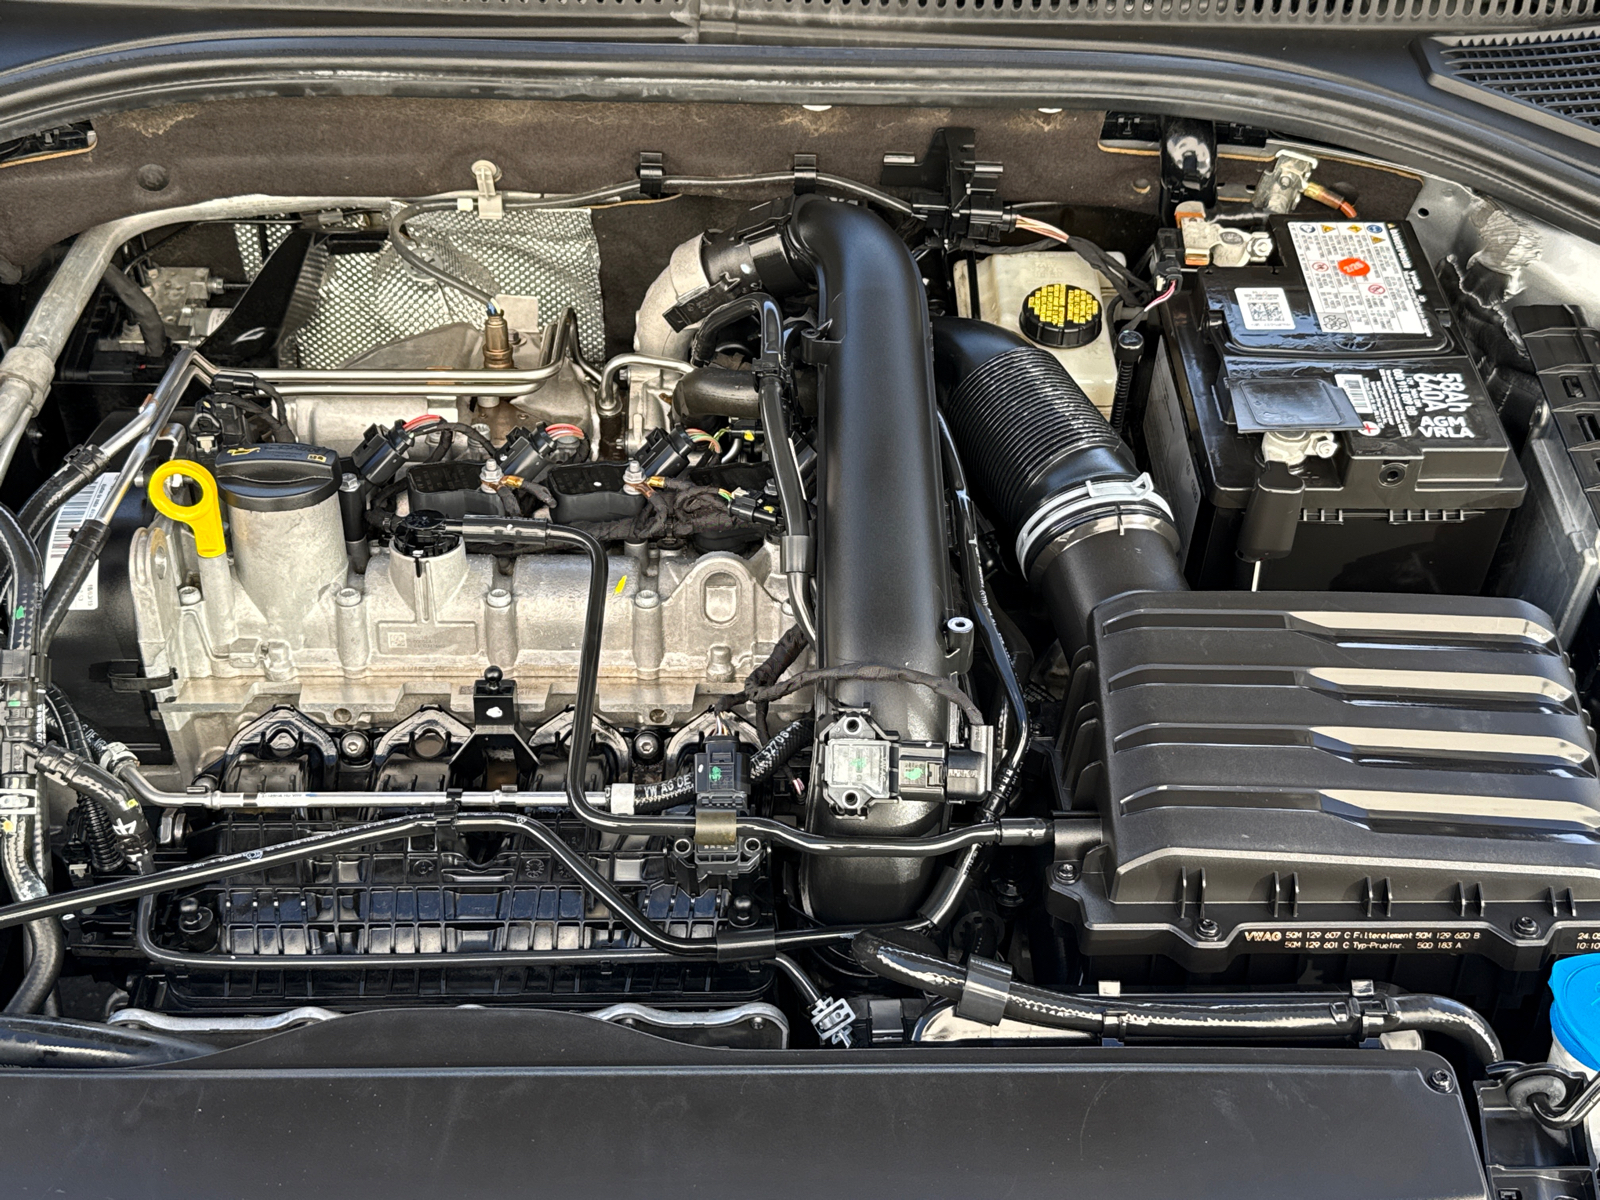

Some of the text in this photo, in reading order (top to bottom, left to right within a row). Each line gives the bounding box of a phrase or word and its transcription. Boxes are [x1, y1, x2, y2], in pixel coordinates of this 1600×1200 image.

[1397, 381, 1409, 393] 915
[1413, 373, 1449, 412] 640A
[1437, 373, 1473, 412] 58Ah
[1420, 416, 1467, 427] AGM
[1418, 427, 1475, 438] VRLA
[661, 780, 674, 794] AG
[1244, 931, 1282, 941] VWAG
[1306, 931, 1321, 939] 129
[1324, 931, 1341, 939] 607
[1344, 931, 1351, 939] C
[1353, 931, 1413, 939] Filterelement
[1305, 941, 1321, 949] 129
[1323, 941, 1338, 949] 601
[1342, 941, 1350, 949] C
